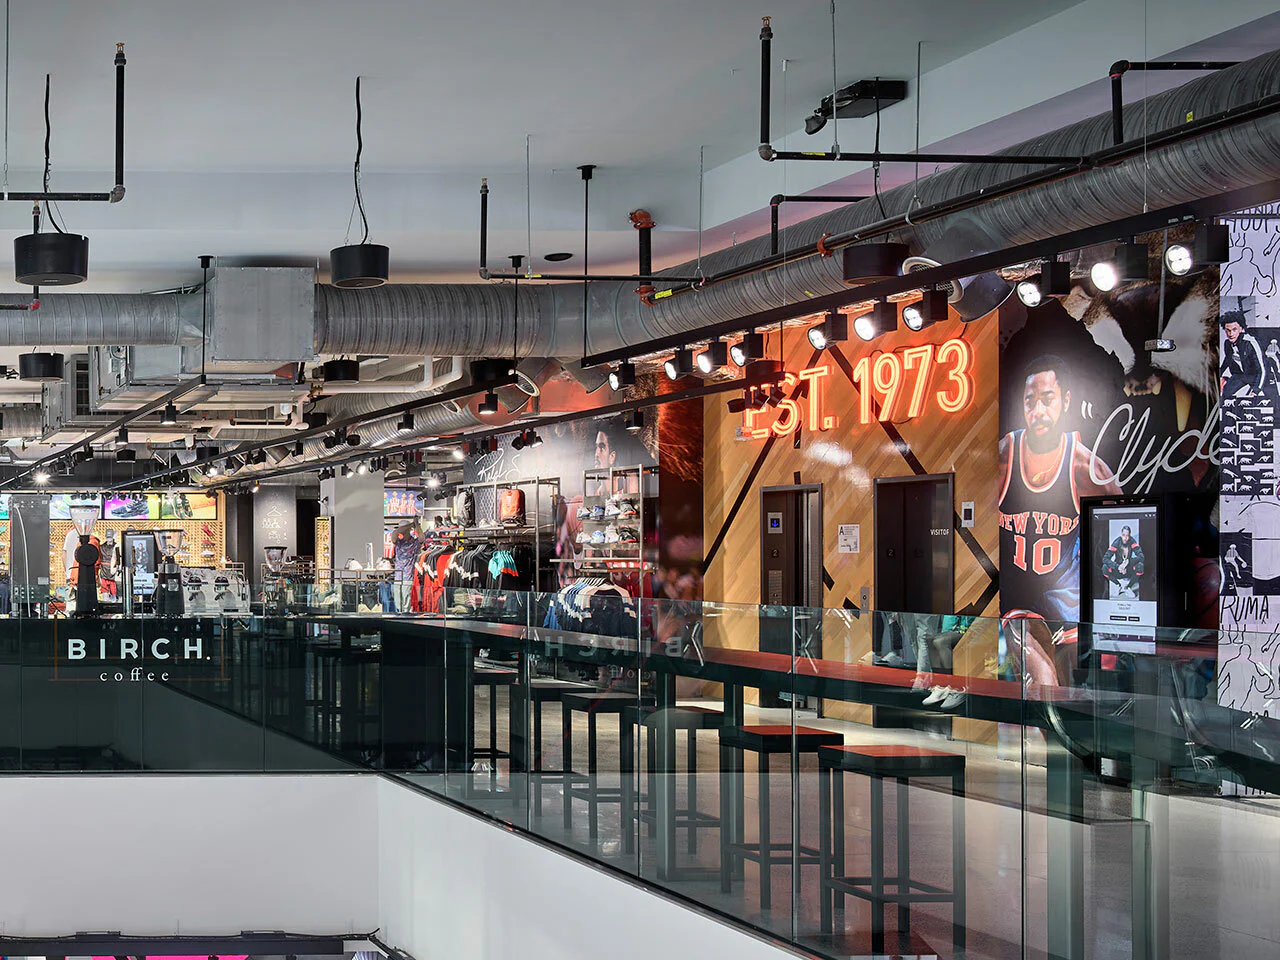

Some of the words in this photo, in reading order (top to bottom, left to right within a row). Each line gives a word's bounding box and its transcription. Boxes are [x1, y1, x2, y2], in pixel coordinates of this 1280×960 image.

[743, 365, 837, 439] EST.
[853, 338, 975, 424] 1973
[1013, 534, 1062, 576] 10
[99, 667, 169, 682] coffee
